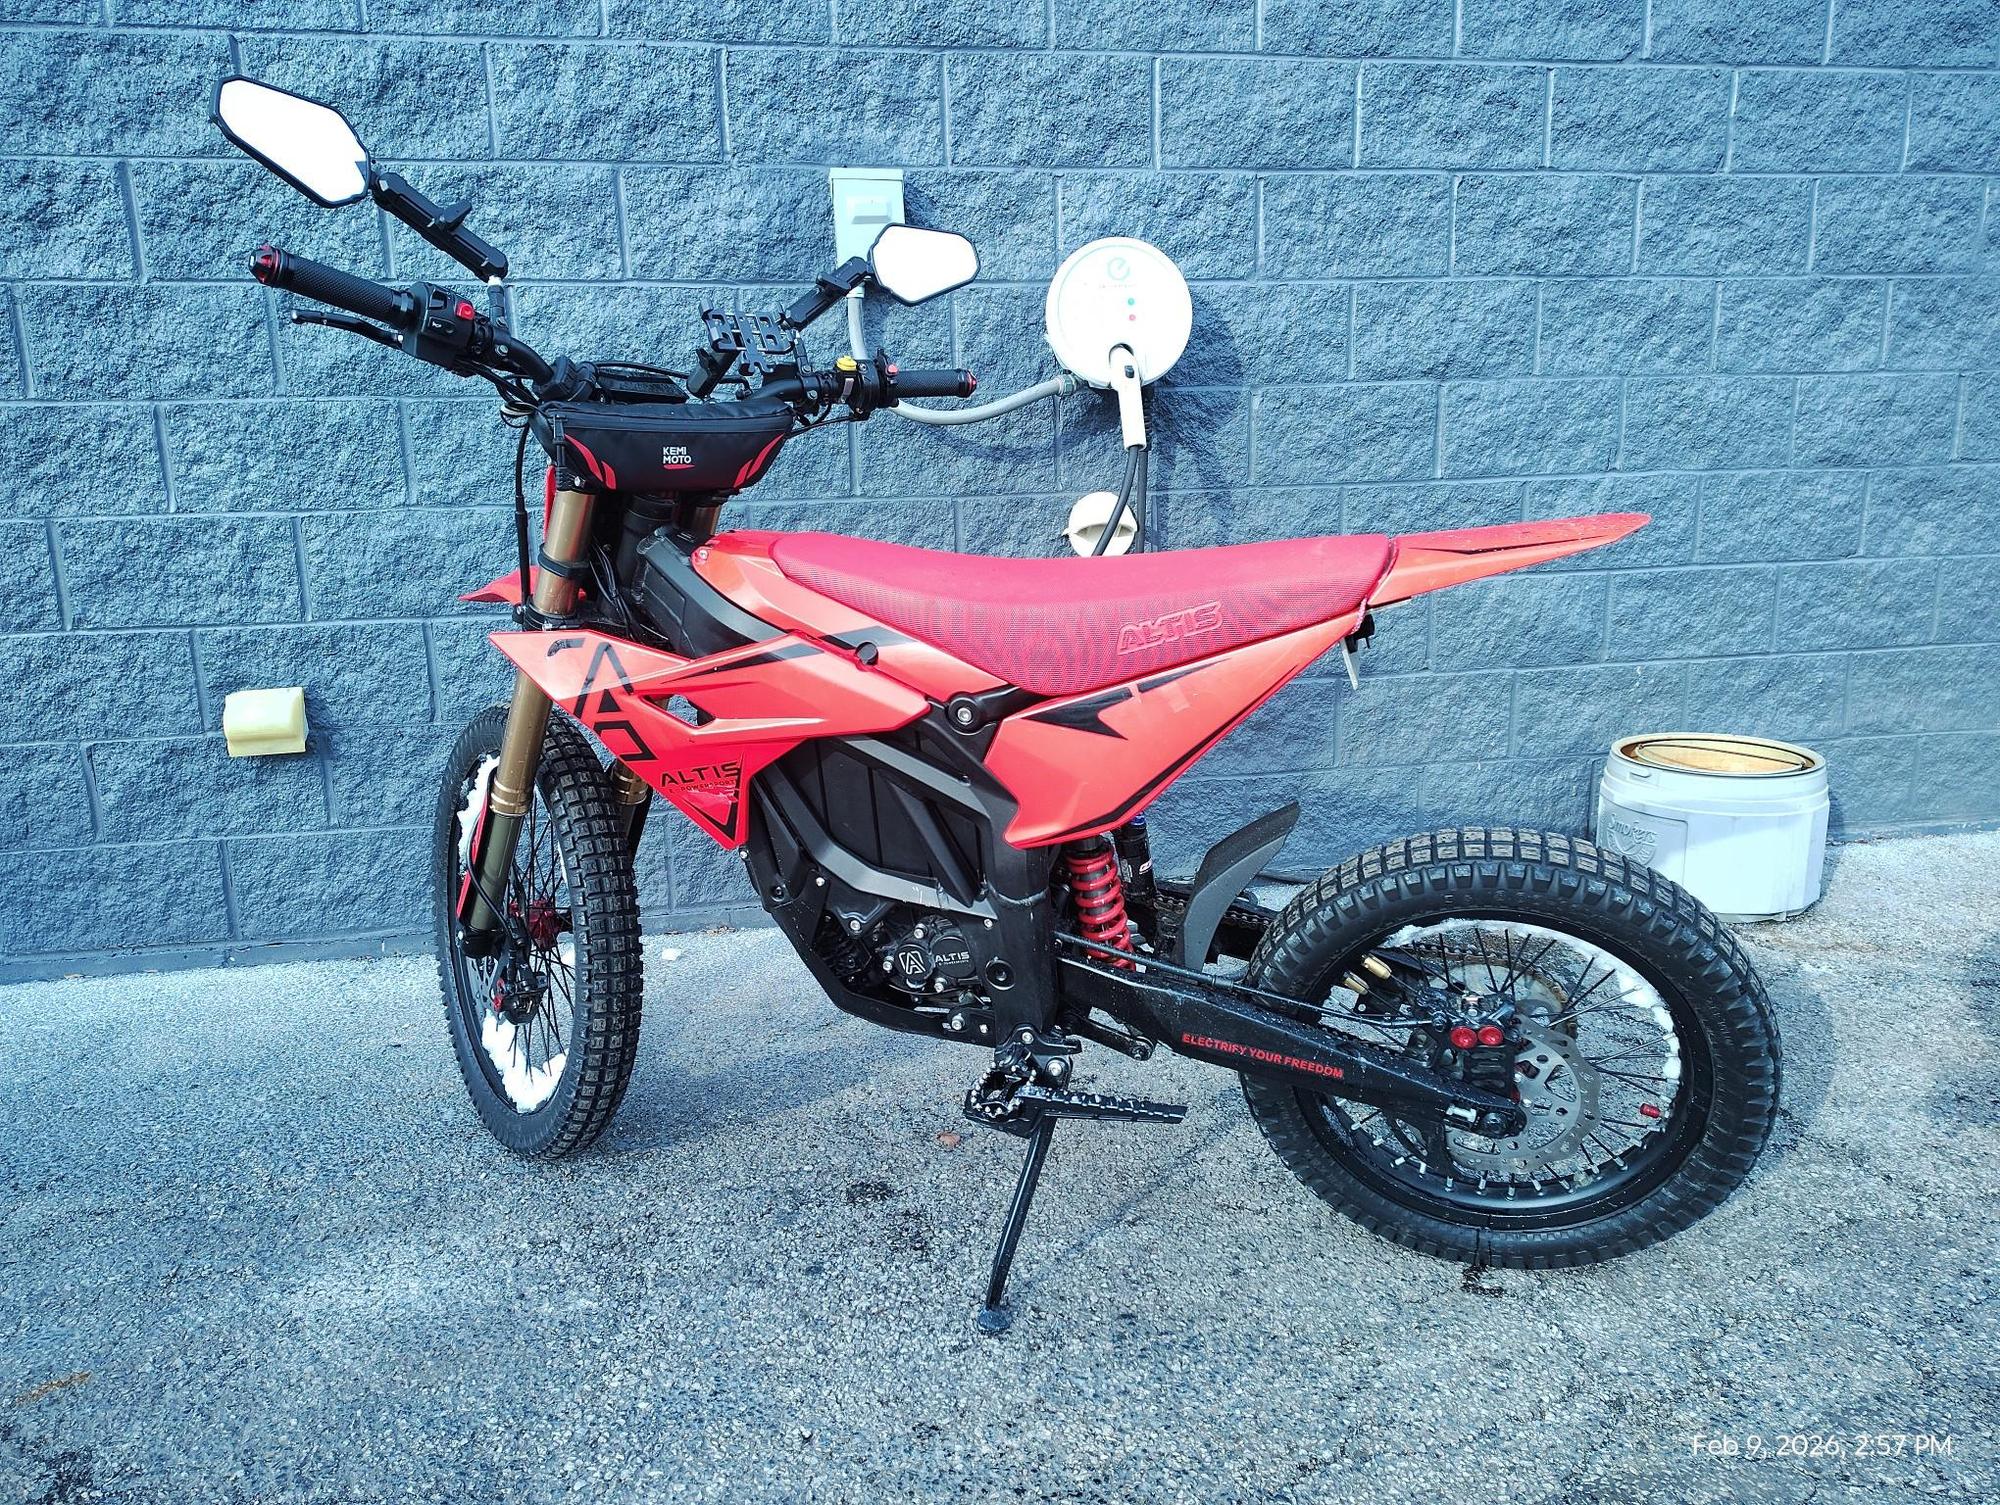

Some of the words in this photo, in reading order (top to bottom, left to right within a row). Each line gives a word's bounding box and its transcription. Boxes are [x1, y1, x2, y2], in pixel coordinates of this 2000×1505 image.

[663, 446, 687, 456] KEMI
[663, 455, 692, 465] MOTO
[1119, 602, 1222, 653] ALTIS
[662, 761, 741, 788] ALTIS
[935, 951, 970, 962] ALTIS
[1182, 1032, 1247, 1056] ELECTRIFY
[1249, 1047, 1282, 1064] YOUR
[1283, 1056, 1345, 1080] FREEDOM
